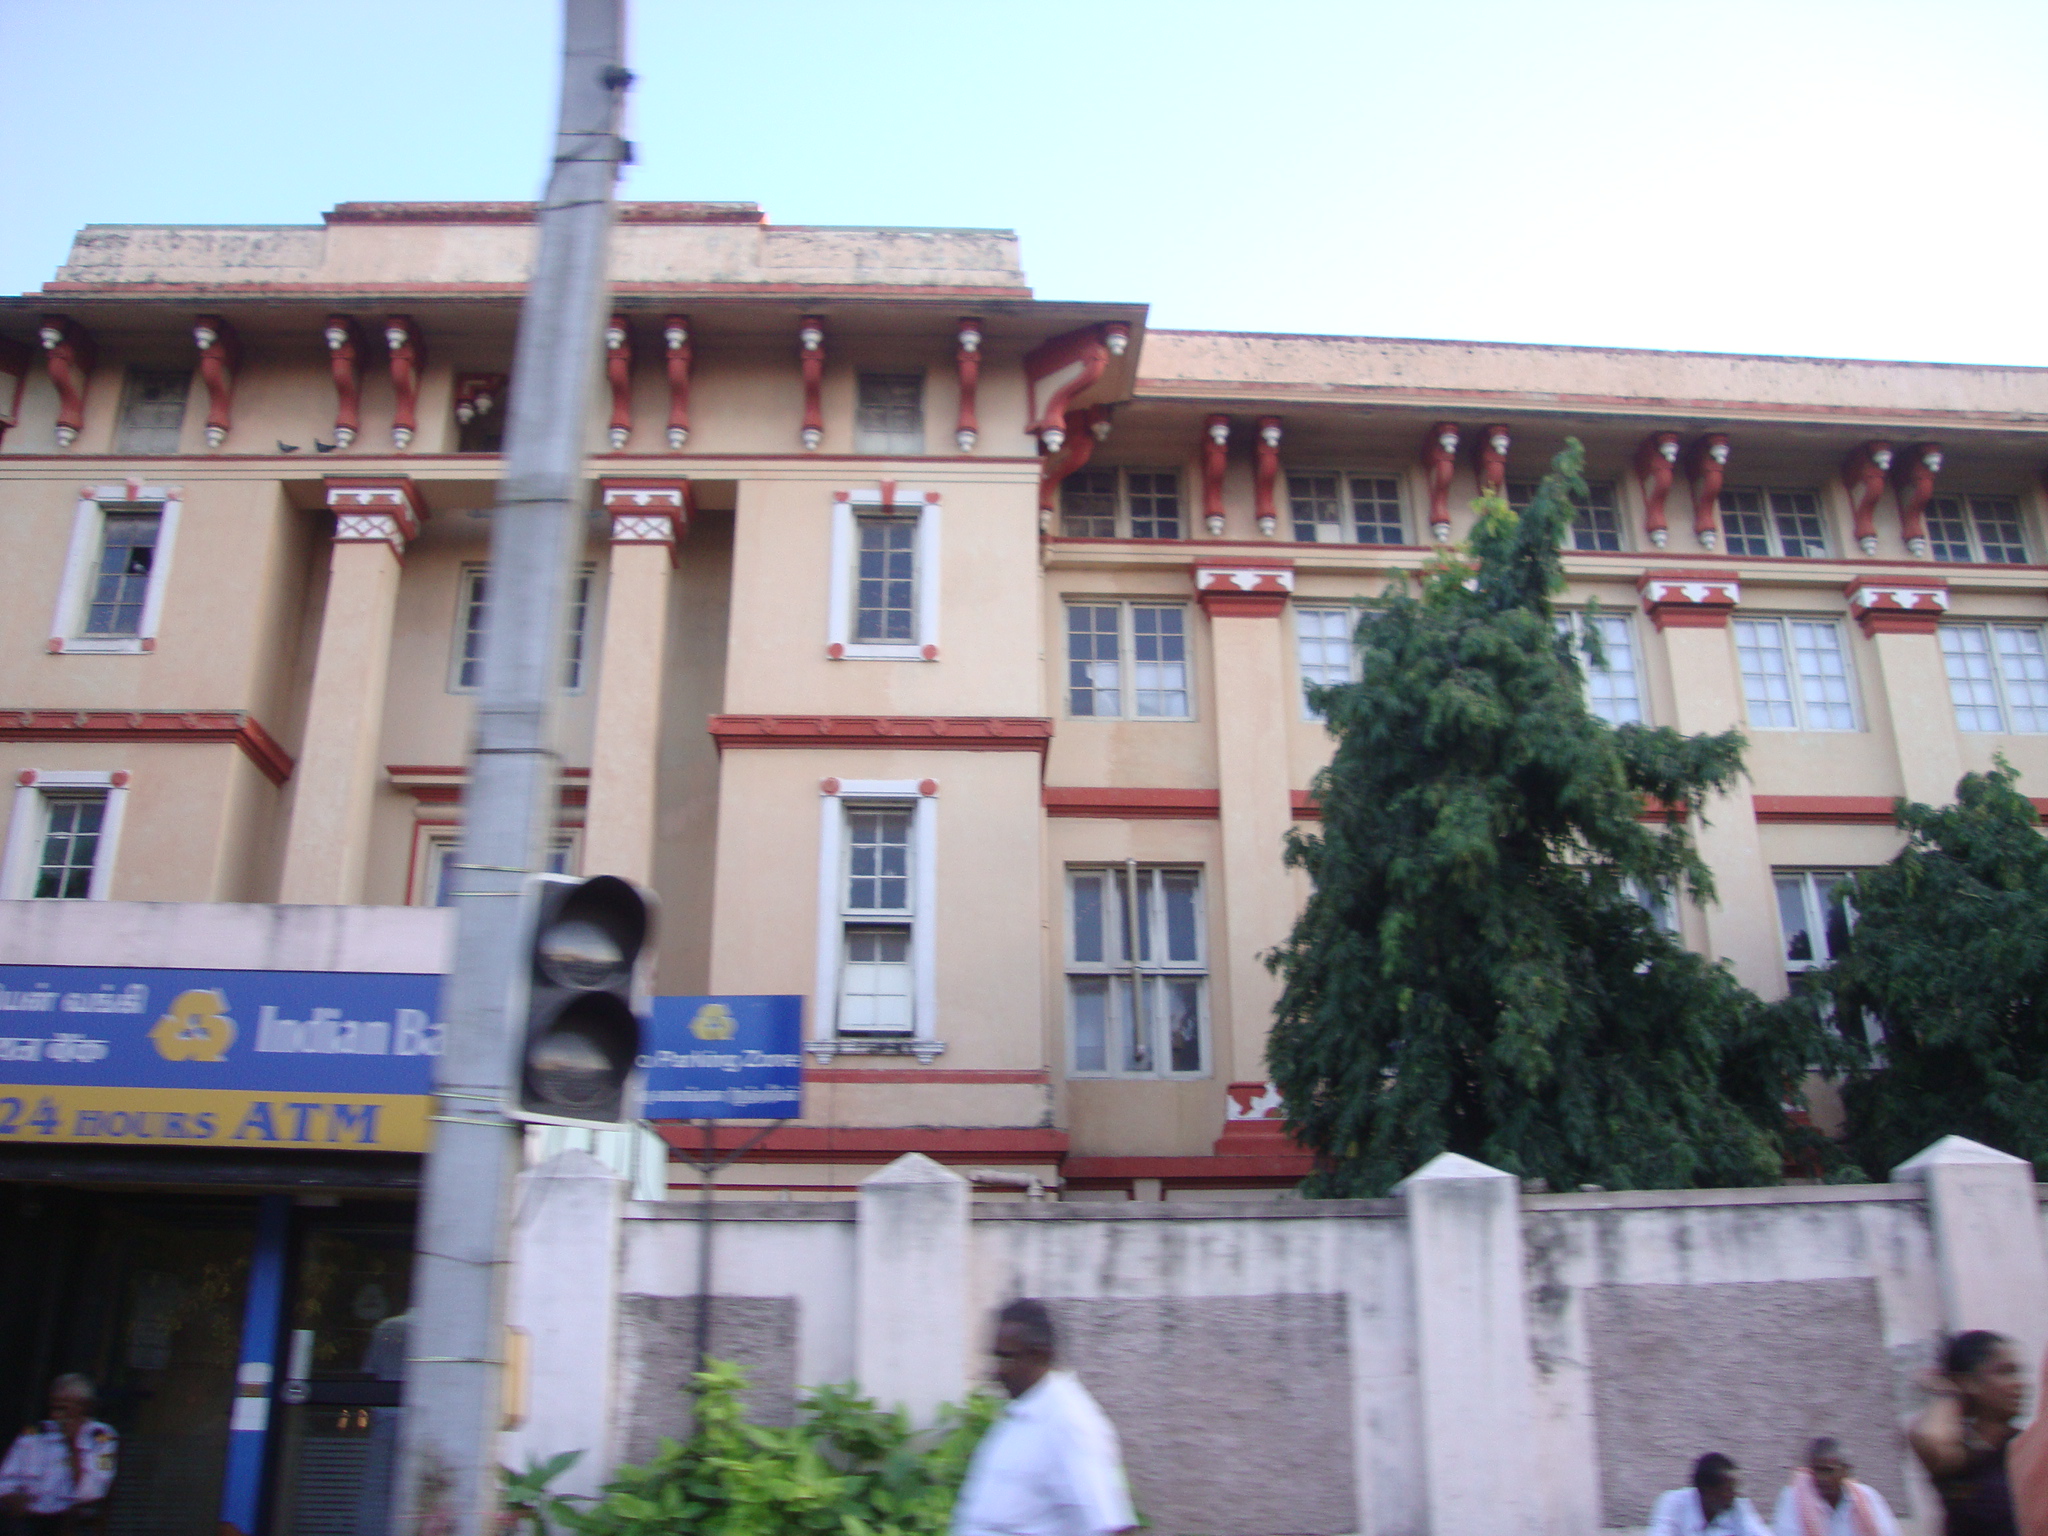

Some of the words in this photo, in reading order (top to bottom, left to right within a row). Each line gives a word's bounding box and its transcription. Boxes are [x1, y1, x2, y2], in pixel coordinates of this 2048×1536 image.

[254, 1005, 391, 1055] Indian
[393, 1008, 450, 1056] Ba
[231, 1101, 383, 1144] ATM
